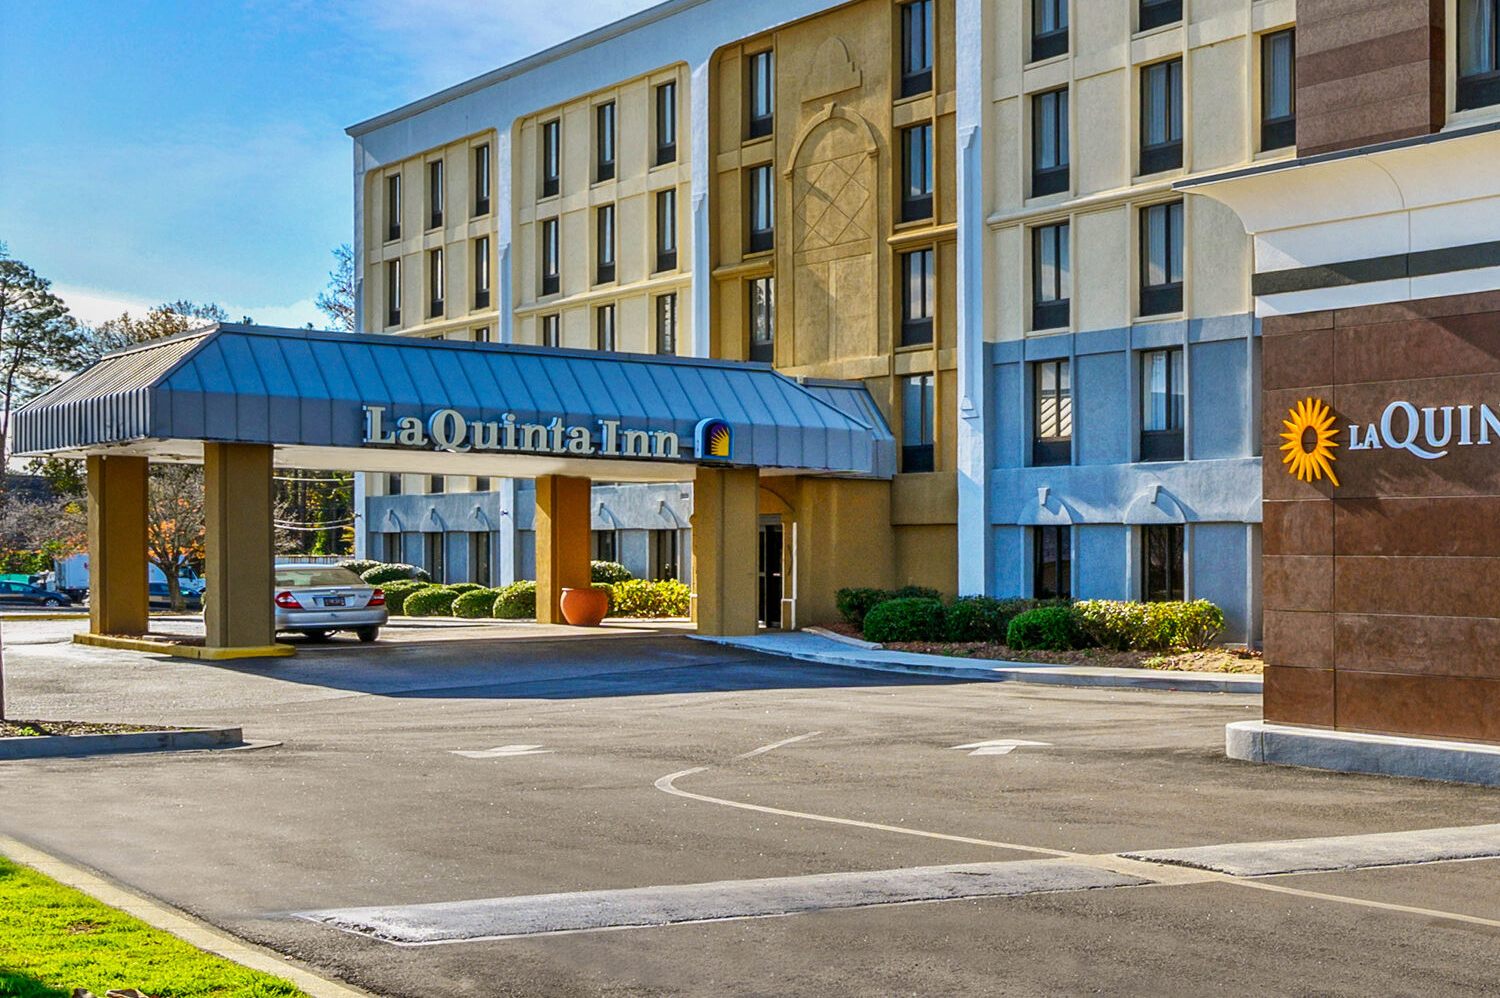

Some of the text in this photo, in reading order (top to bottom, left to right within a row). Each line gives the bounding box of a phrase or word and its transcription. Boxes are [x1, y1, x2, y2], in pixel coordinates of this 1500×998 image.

[362, 404, 682, 459] La Quinta Inn
[1349, 423, 1383, 450] LA
